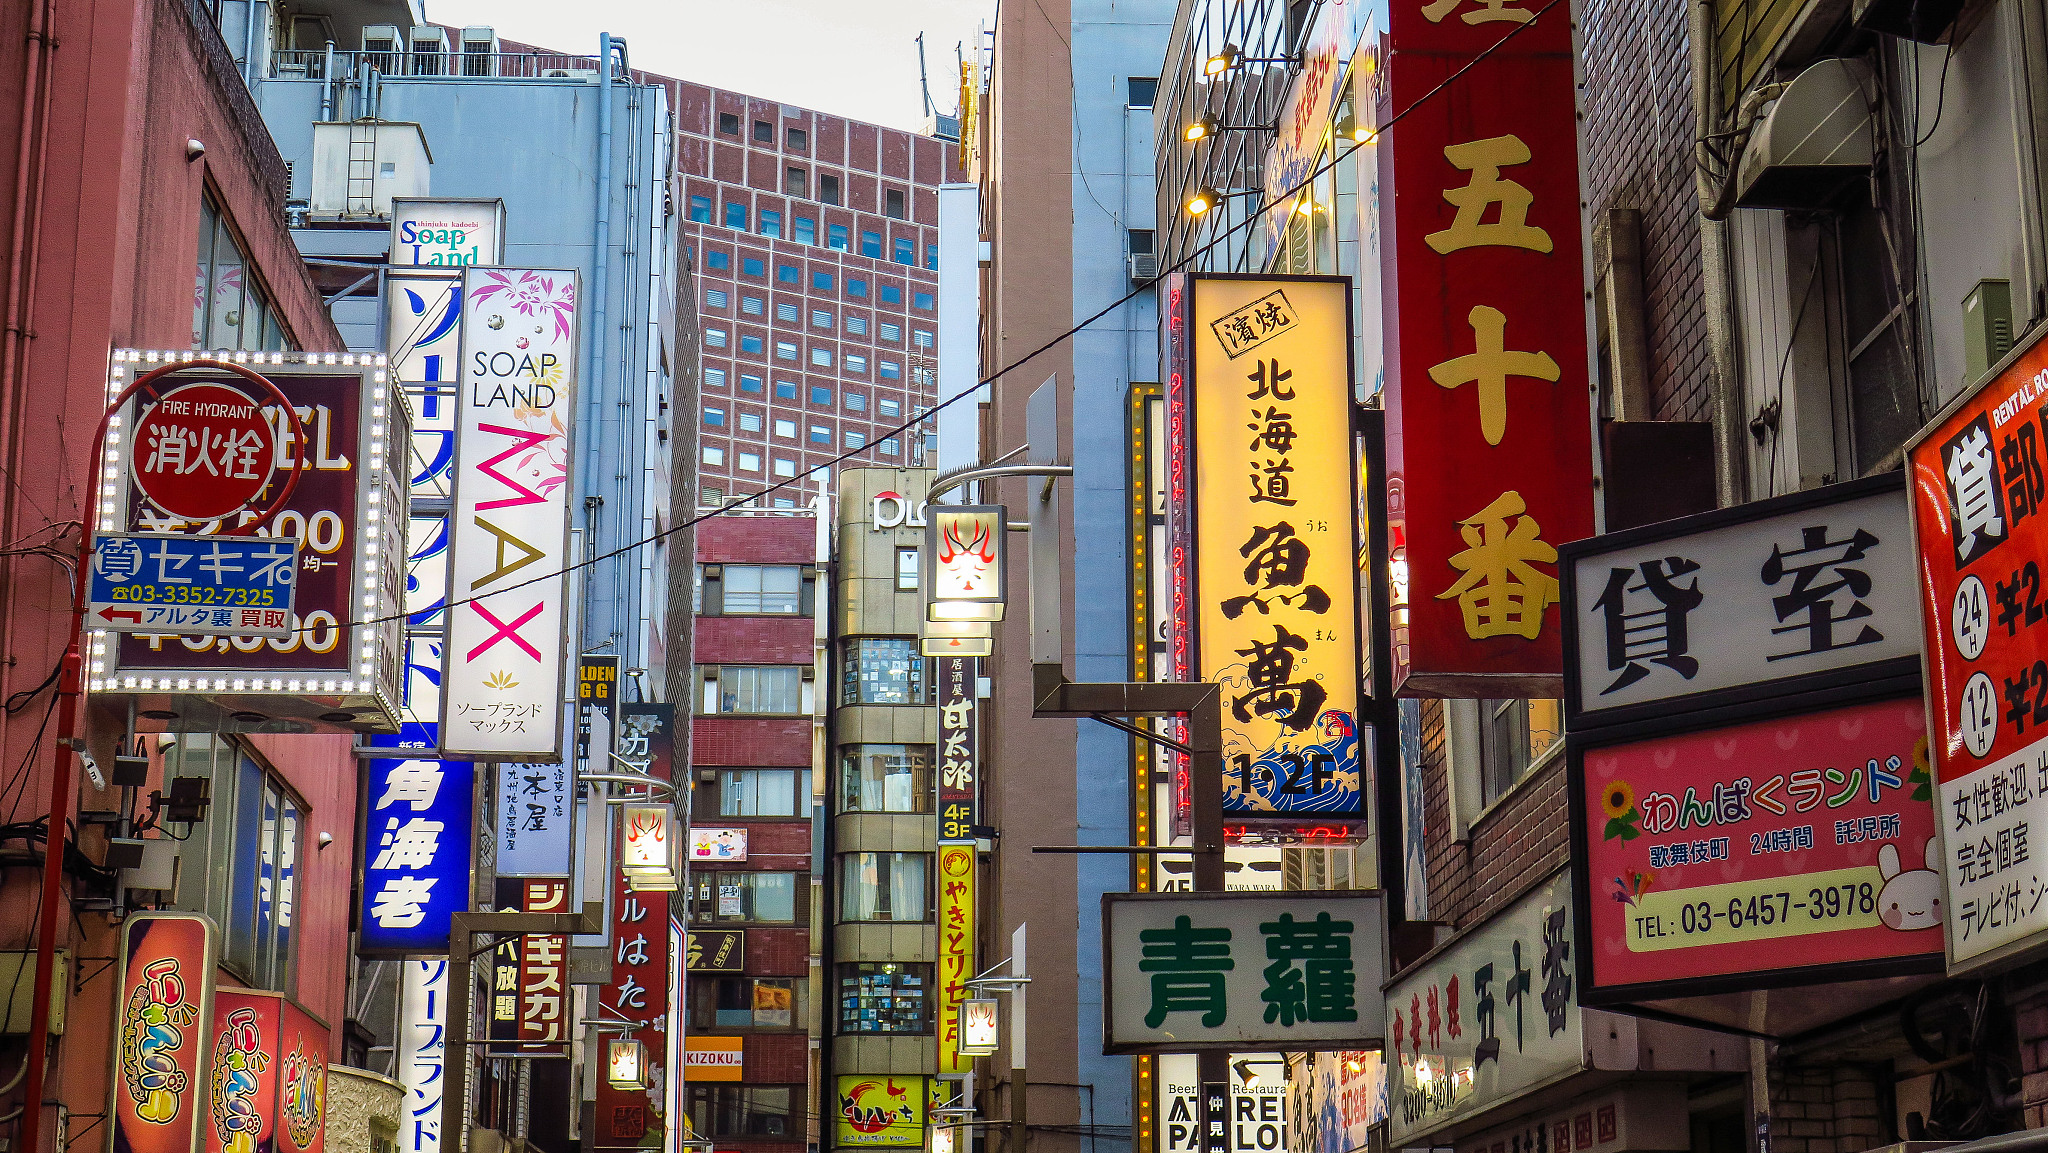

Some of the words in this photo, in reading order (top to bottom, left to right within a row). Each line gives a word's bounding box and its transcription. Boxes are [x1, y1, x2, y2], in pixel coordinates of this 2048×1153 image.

[400, 220, 466, 250] Soap
[412, 245, 478, 266] Land
[473, 351, 557, 378] SOAP
[1424, 134, 1560, 640] 五十番
[162, 400, 190, 416] FIRE
[195, 402, 256, 421] HYDRANT
[473, 383, 557, 409] LAND
[1993, 384, 2036, 429] RENTAL
[144, 424, 264, 480] 消火栓
[1246, 358, 1298, 507] 北海道
[466, 422, 551, 664] MAX
[1306, 518, 1328, 533] うお
[303, 556, 338, 573] 均一
[130, 584, 275, 607] 03-3352-7325
[146, 607, 233, 628] アルタ裏
[240, 609, 285, 629] 買取
[1591, 526, 1884, 695] 貸室
[1958, 584, 1982, 637] 24
[1220, 520, 1331, 732] 魚萬
[1315, 629, 1336, 643] まん
[950, 658, 965, 696] 居酒屋
[456, 702, 542, 719] ソープランド
[470, 719, 525, 734] マックス
[1968, 681, 1991, 732] 12
[940, 697, 974, 791] 甘太郎
[521, 763, 551, 831] 本屋
[944, 804, 970, 820] 4F
[1643, 755, 1902, 834] わんぱくランド
[370, 759, 445, 929] 角海老
[944, 821, 970, 838] 3F
[1650, 837, 1729, 868] 歌舞伎町
[1750, 826, 1813, 855] 24時間
[1835, 814, 1901, 845] 託児所
[1958, 820, 2029, 887] 完全個室
[1227, 884, 1250, 892] WARA
[1253, 884, 1276, 892] WARA
[1682, 882, 1875, 934] 03-6457-3978
[1961, 875, 2048, 941] テレビ付、シ
[522, 884, 564, 1048] ジギスカン
[412, 960, 446, 1151] ソープランド
[1168, 1084, 1196, 1094] Beer
